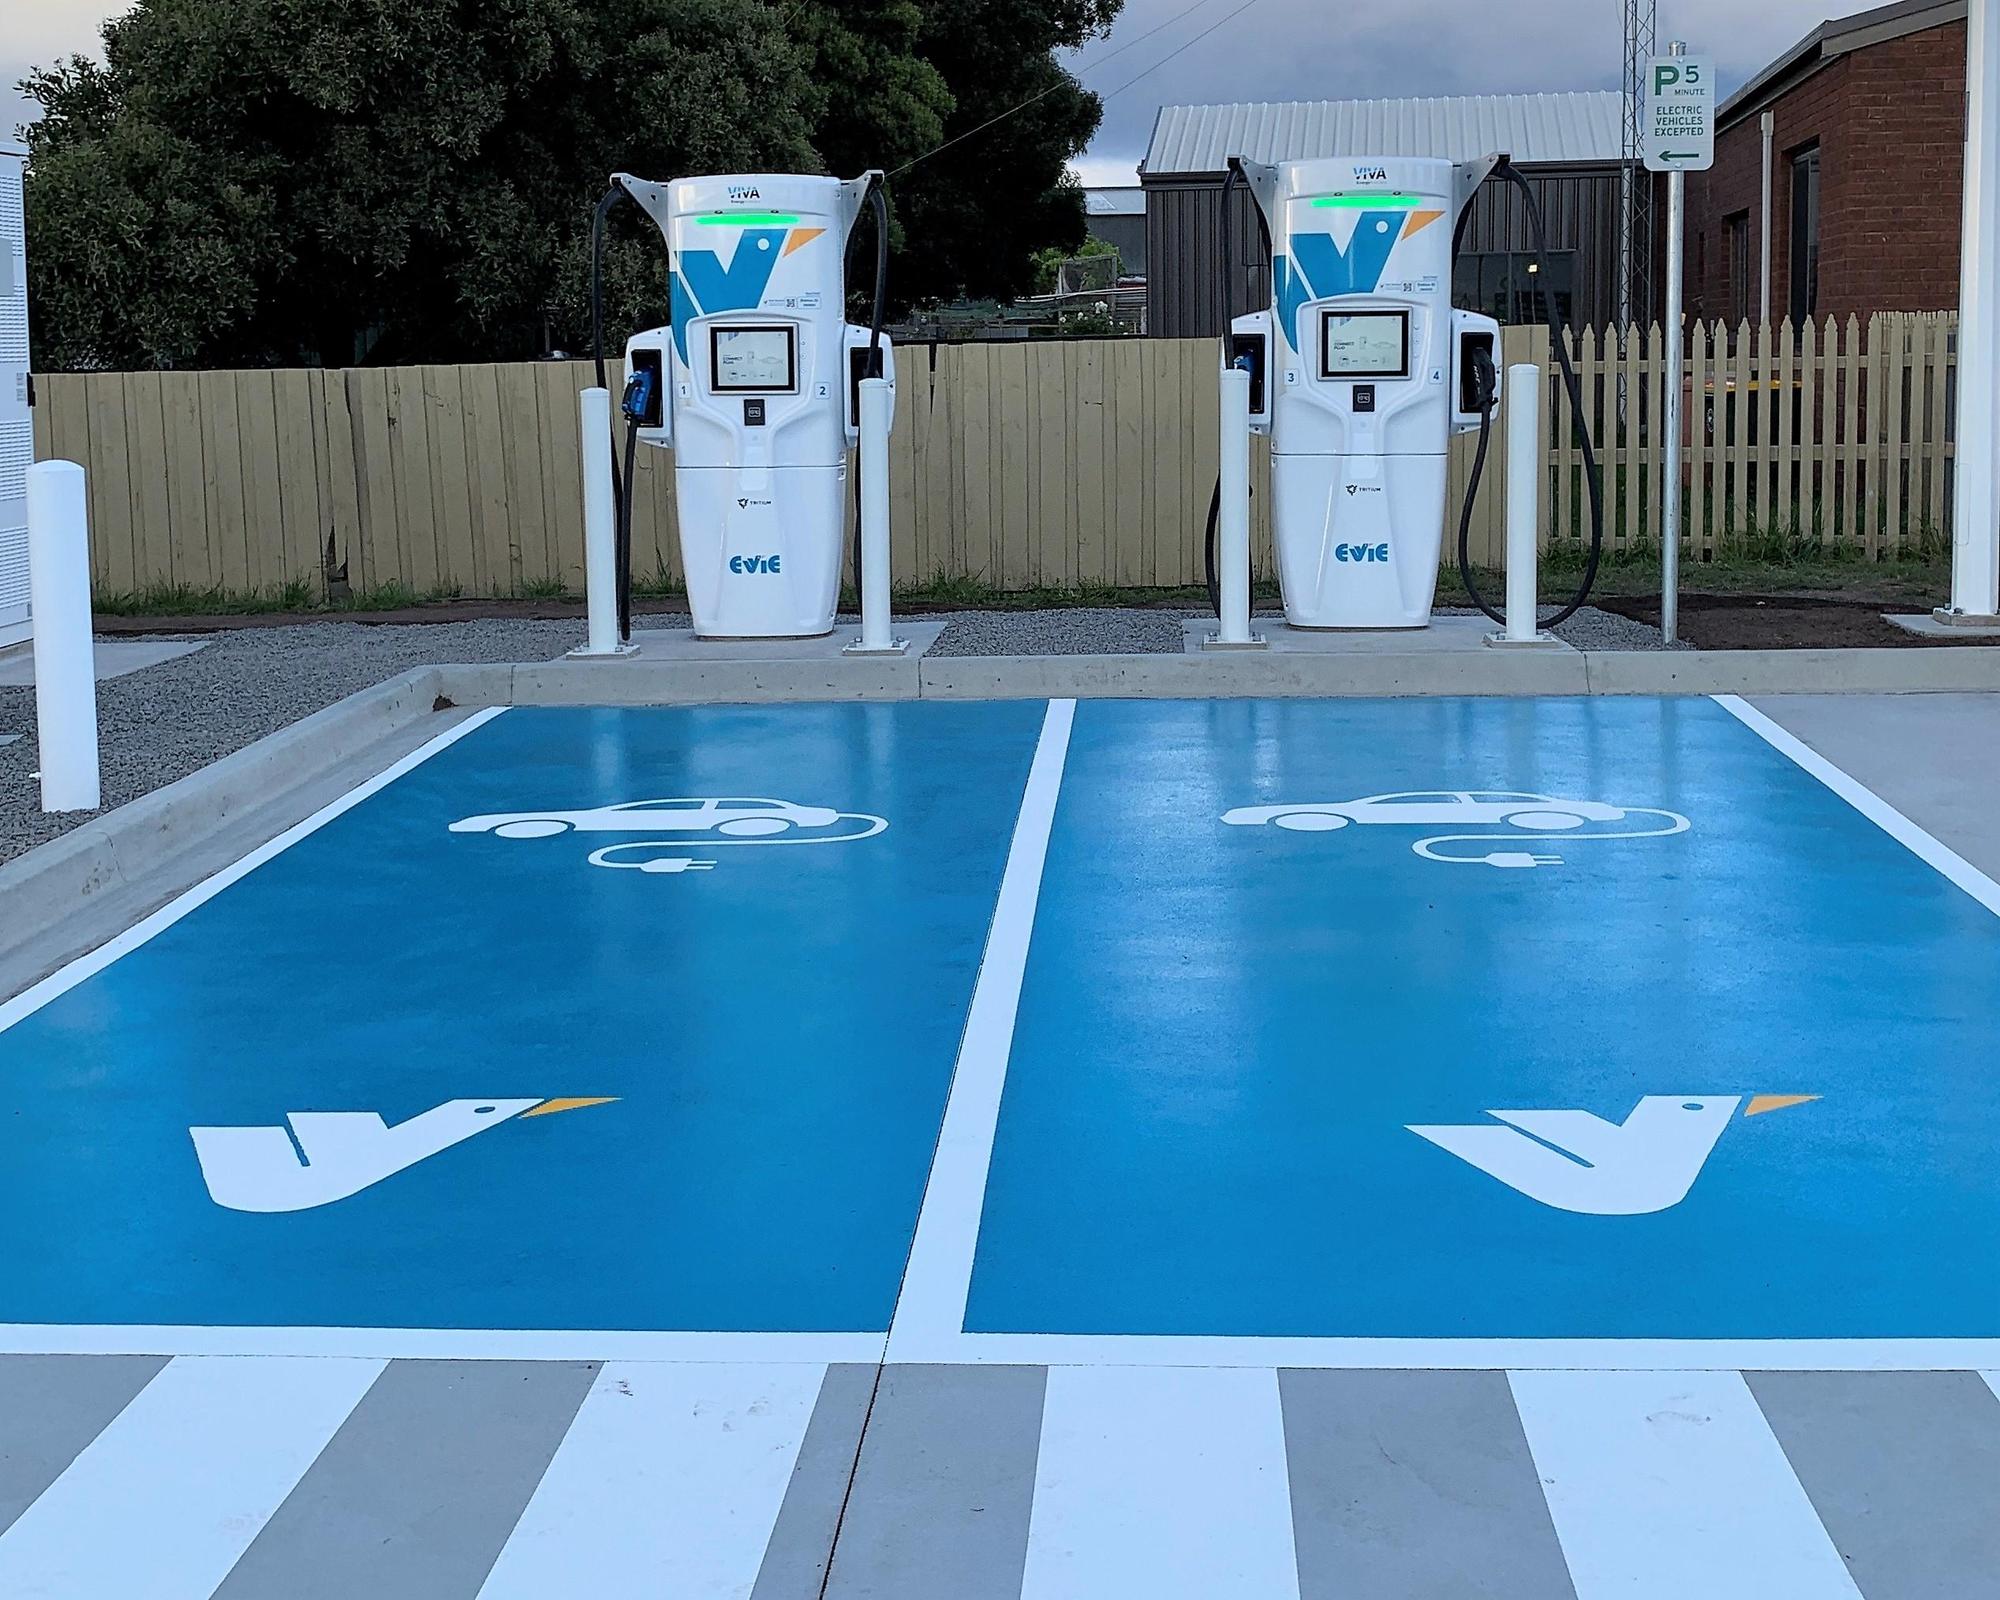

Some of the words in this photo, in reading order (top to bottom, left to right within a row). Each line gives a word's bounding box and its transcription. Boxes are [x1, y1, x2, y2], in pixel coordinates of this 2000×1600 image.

[1655, 65, 1680, 96] P
[1685, 65, 1700, 84] 5
[1674, 88, 1705, 96] MINUTE
[1656, 105, 1703, 116] ELECTRIC
[1655, 116, 1704, 126] VEHICLES
[1654, 127, 1704, 137] EXCEPTED
[1353, 167, 1387, 180] VIVA
[728, 186, 761, 199] VIVA
[1287, 372, 1295, 382] 3
[1432, 370, 1440, 380] 4
[681, 385, 687, 395] 1
[819, 385, 826, 396] 2
